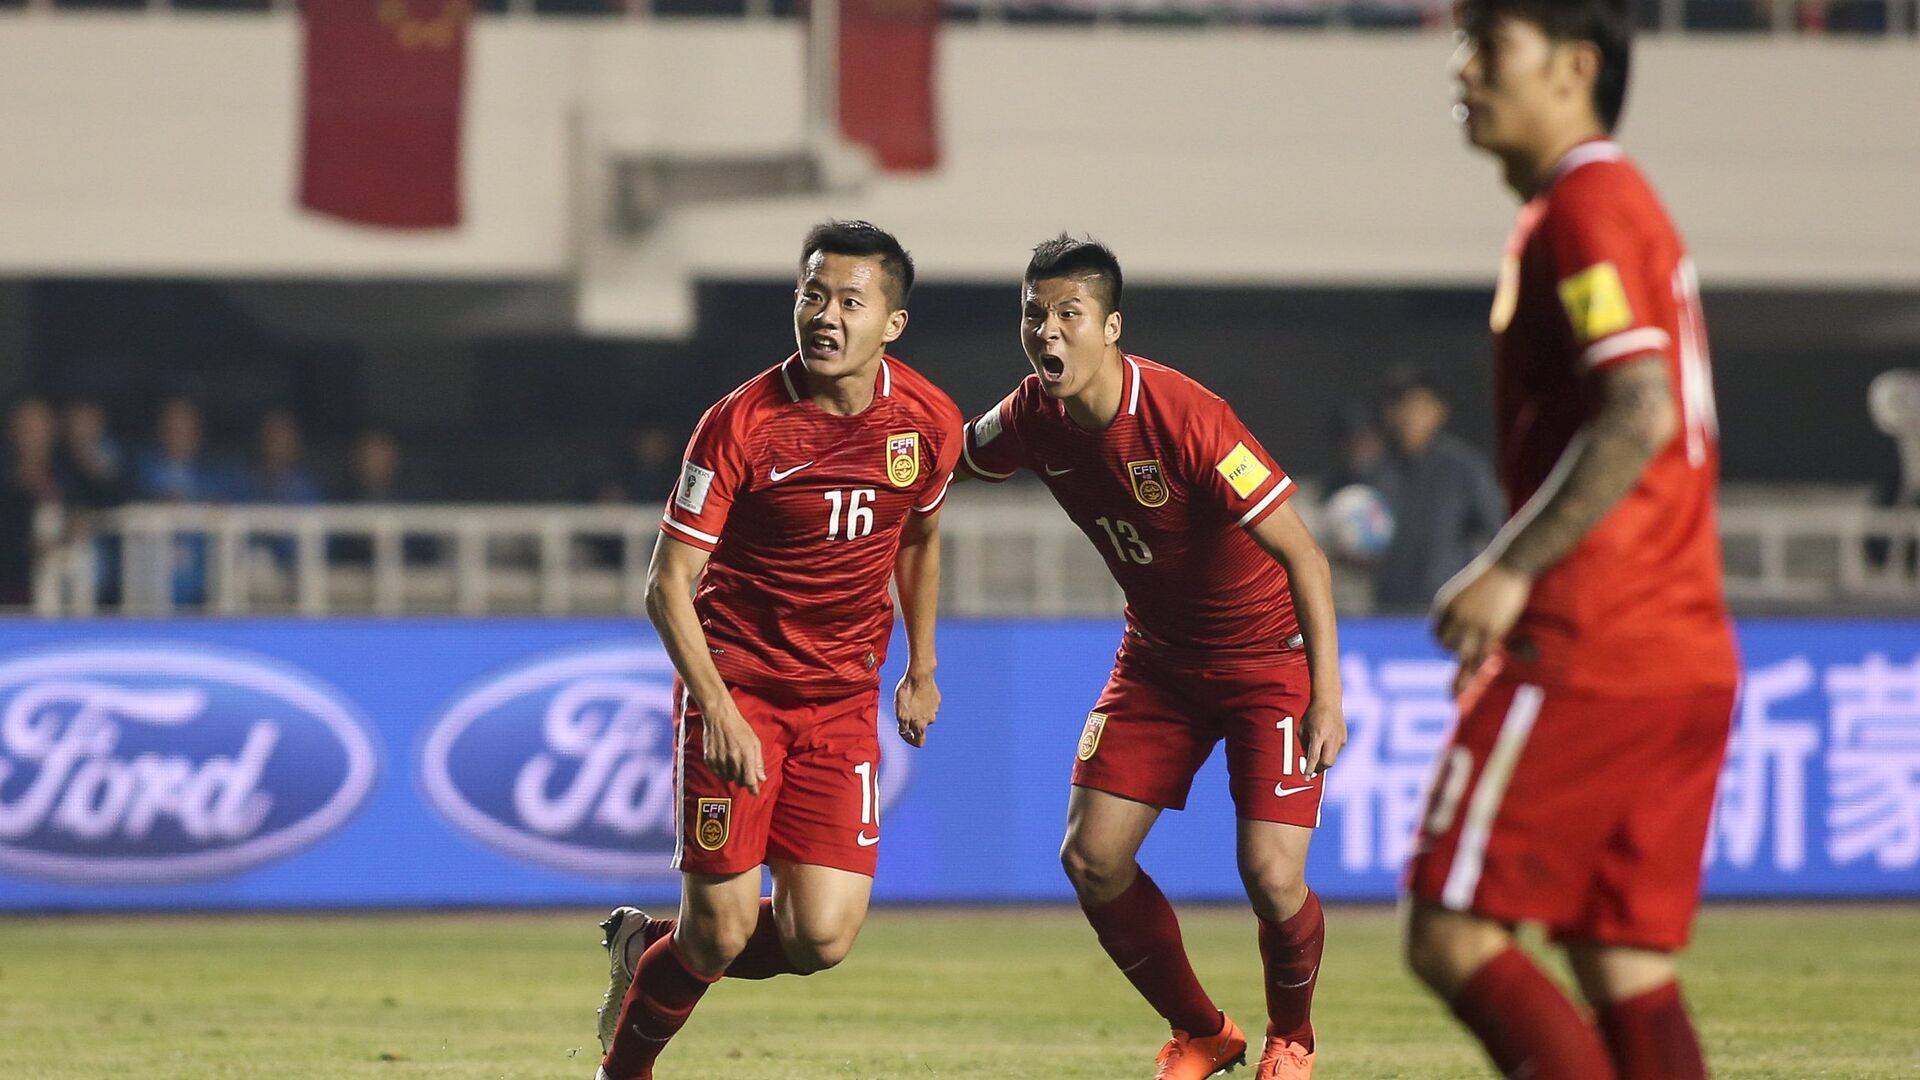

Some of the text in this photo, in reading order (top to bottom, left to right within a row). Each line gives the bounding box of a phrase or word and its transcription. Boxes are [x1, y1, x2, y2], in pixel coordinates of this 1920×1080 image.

[890, 438, 914, 450] CFA
[1133, 464, 1158, 475] CFA
[1229, 463, 1248, 481] FIFA
[824, 488, 877, 542] 16
[1096, 516, 1154, 565] 13
[0, 681, 281, 841] Ford
[513, 677, 674, 836] Fo
[702, 803, 726, 813] CFA
[854, 761, 880, 828] 1
